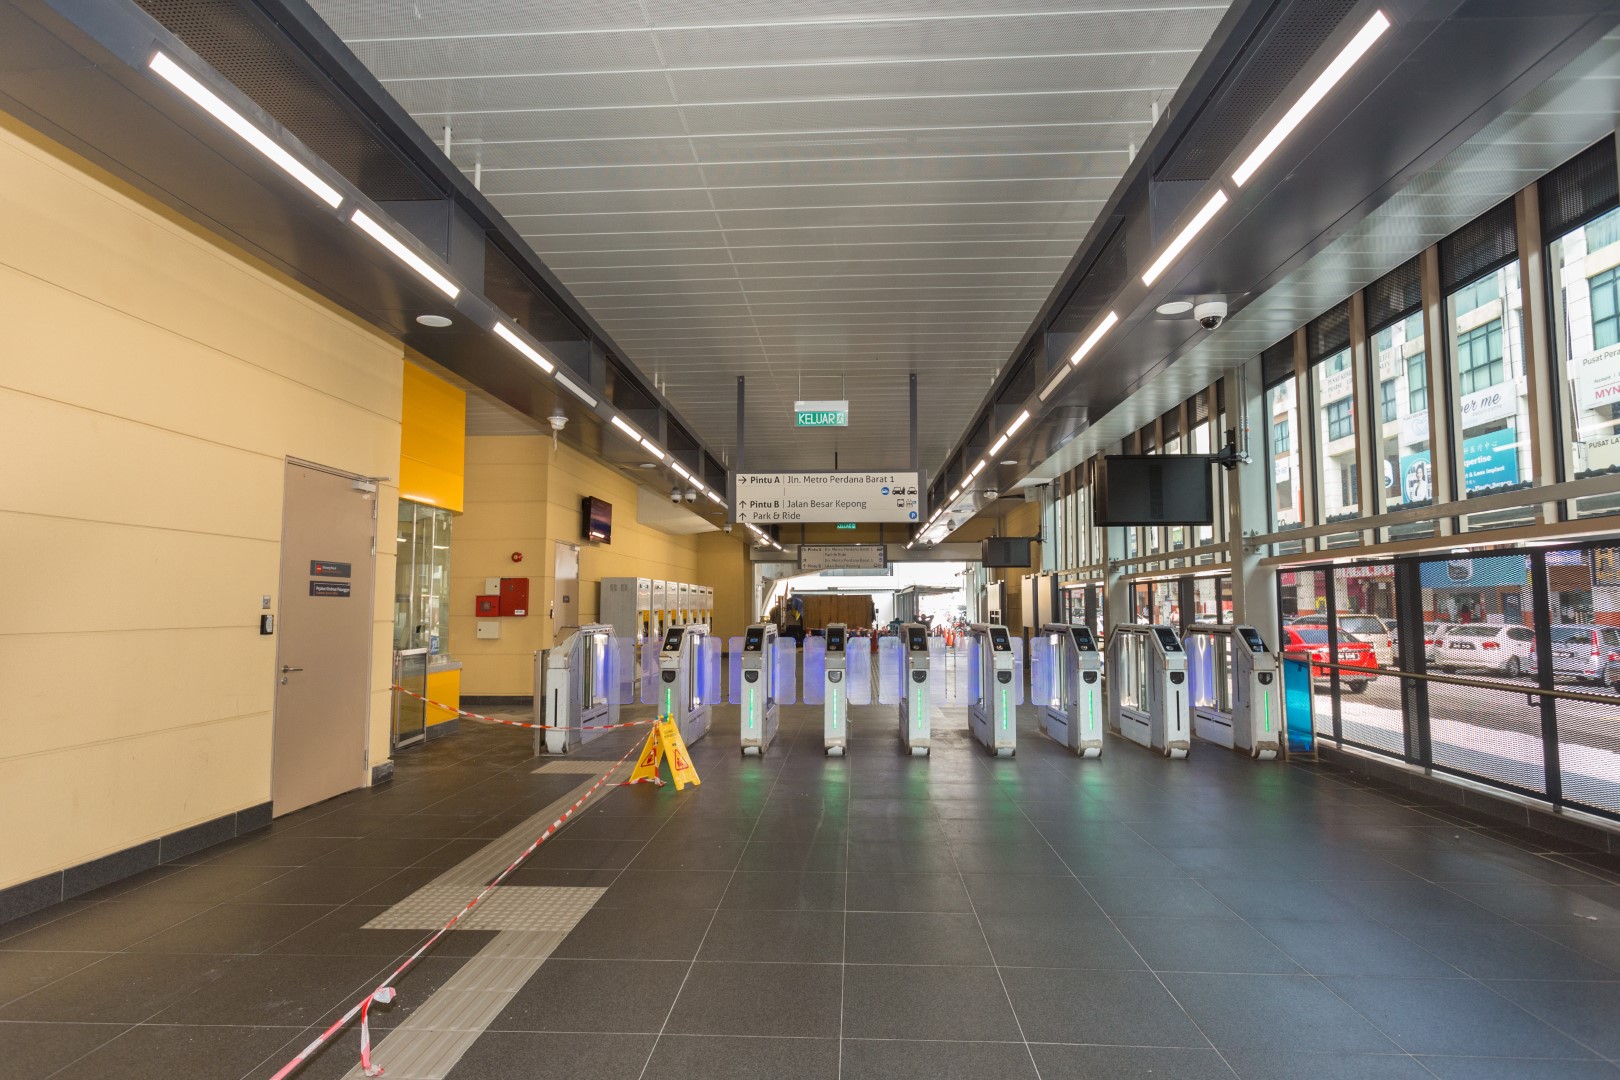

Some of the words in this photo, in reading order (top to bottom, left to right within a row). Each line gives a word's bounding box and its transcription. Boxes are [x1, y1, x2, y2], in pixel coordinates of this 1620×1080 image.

[1583, 354, 1603, 366] Pusat
[1481, 393, 1501, 408] me
[798, 413, 834, 424] KELUAR
[1589, 440, 1609, 449] PUSAT
[1611, 437, 1620, 445] LA
[750, 476, 773, 484] Pintu
[774, 476, 780, 484] A
[787, 476, 802, 484] Jln.
[803, 476, 828, 484] Metro
[830, 475, 864, 484] Perdana
[866, 475, 888, 483] Barat
[750, 500, 772, 509] Pintu
[774, 500, 780, 508] B
[787, 500, 809, 508] Jalan
[810, 500, 834, 508] Besar
[835, 500, 867, 509] Kepong
[753, 512, 772, 520] Park
[773, 512, 780, 520] &
[782, 511, 801, 520] Ride
